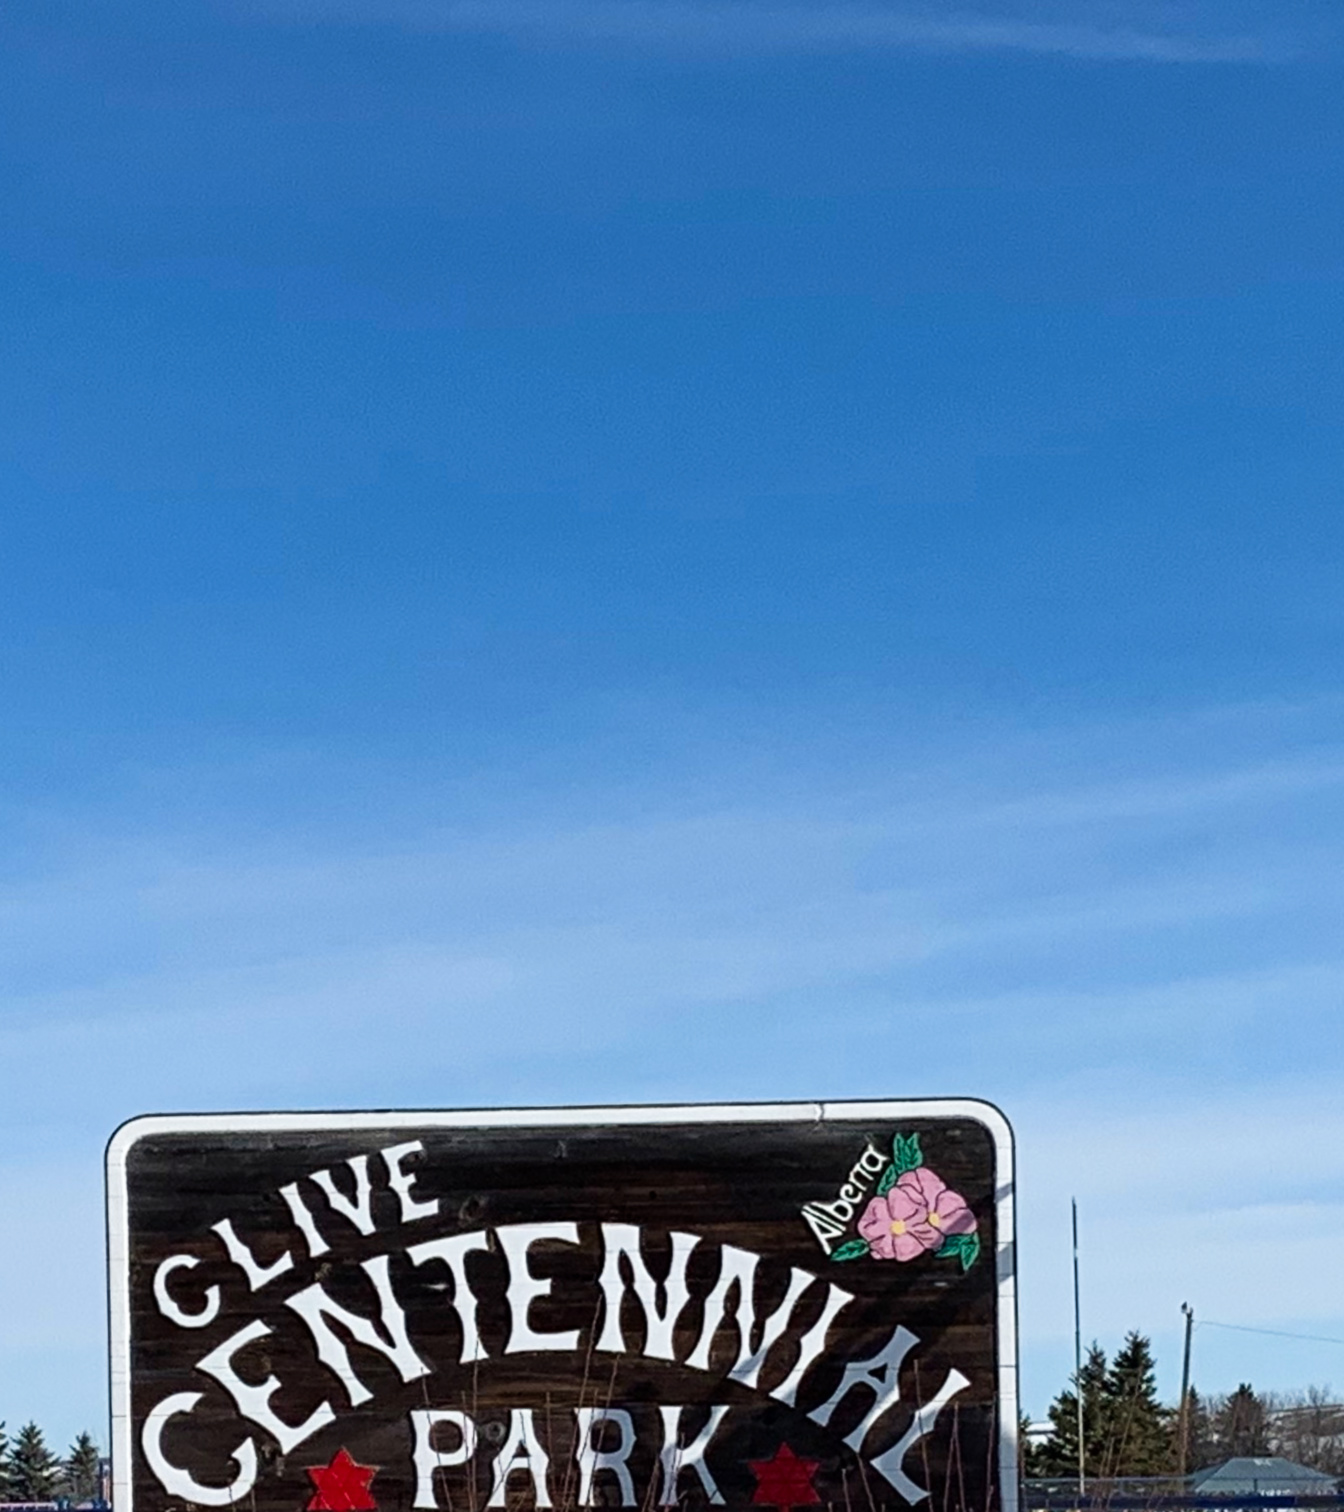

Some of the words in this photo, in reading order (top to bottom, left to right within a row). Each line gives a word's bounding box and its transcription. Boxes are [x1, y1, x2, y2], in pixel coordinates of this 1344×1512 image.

[152, 1140, 440, 1328] CLIVE
[801, 1143, 890, 1256] Alberta
[140, 1221, 971, 1507] CENTENNIAL
[411, 1404, 731, 1509] PARK
